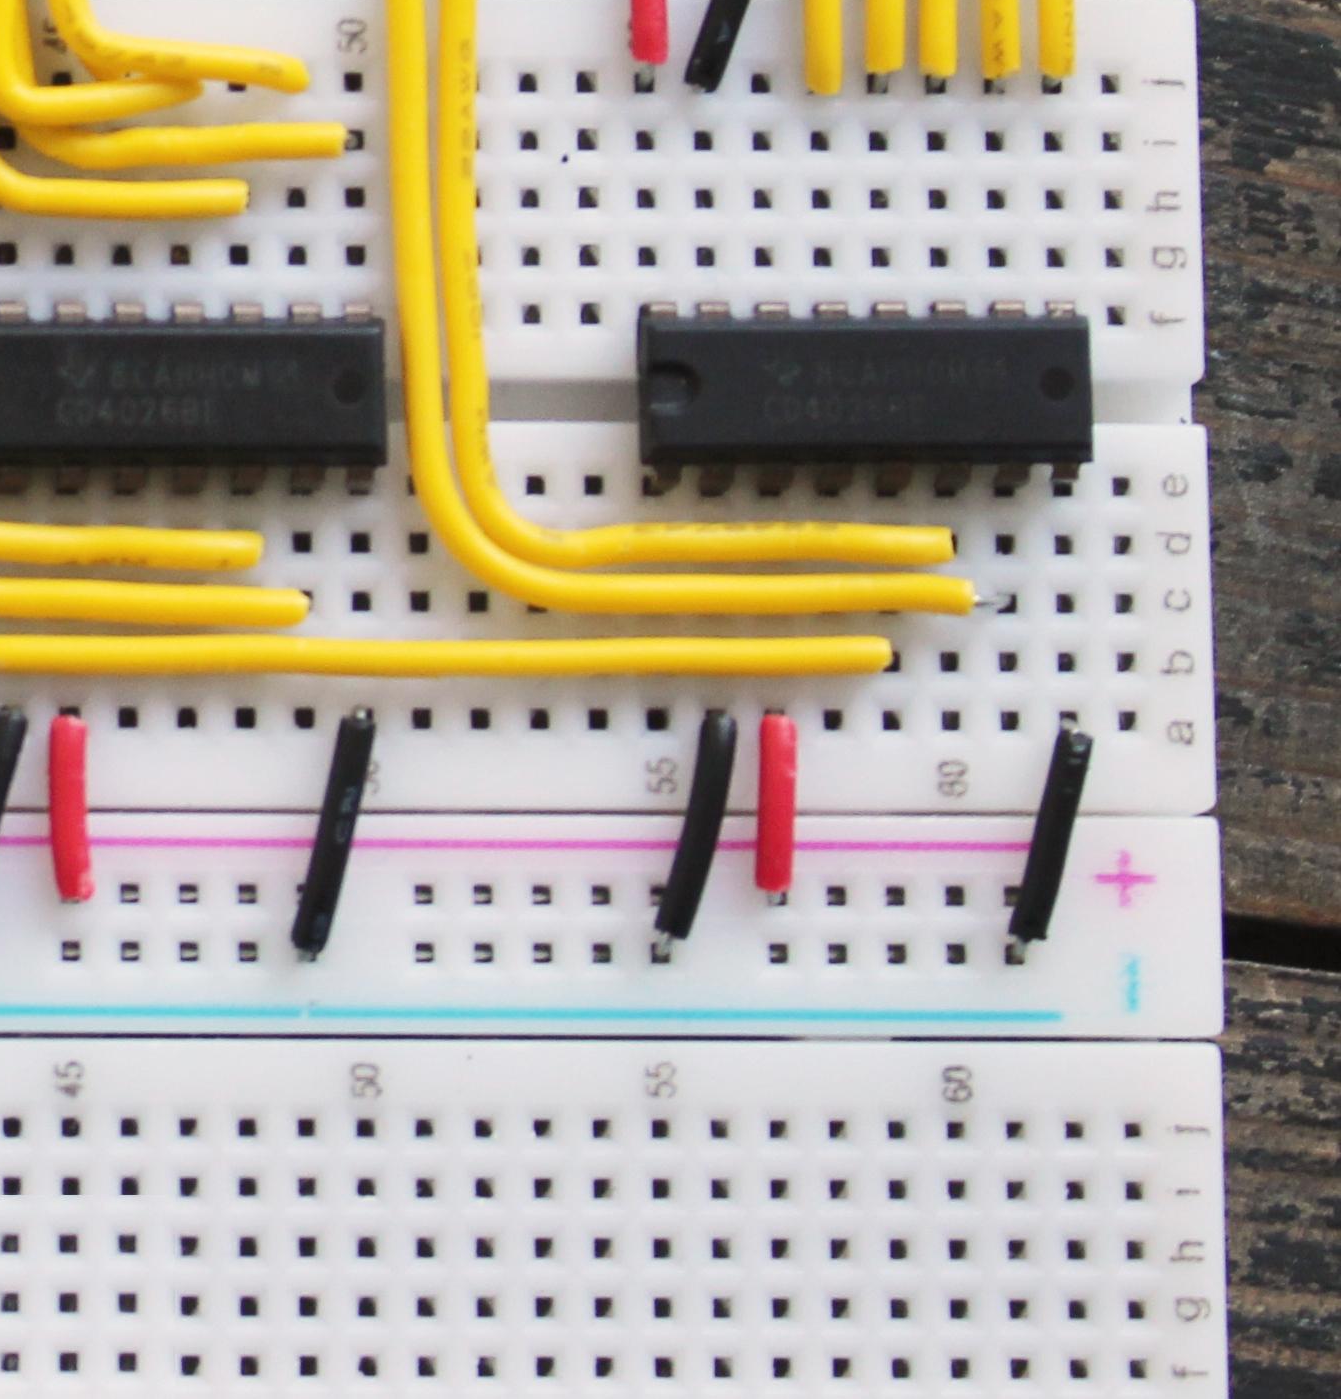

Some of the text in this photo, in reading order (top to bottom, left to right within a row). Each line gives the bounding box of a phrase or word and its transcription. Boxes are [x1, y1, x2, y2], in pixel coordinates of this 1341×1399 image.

[339, 18, 369, 55] 50
[1145, 190, 1181, 214] h
[1150, 245, 1187, 271] g
[1160, 473, 1189, 499] e
[1155, 531, 1193, 557] d
[1162, 589, 1192, 614] c
[1159, 649, 1195, 677] b
[1166, 720, 1195, 747] a
[646, 757, 683, 799] 55
[54, 1060, 82, 1099] 45
[350, 1062, 383, 1098] 50
[644, 1062, 677, 1099] 55
[941, 1065, 974, 1105] 60
[1168, 1239, 1204, 1264] h
[1174, 1296, 1211, 1324] g
